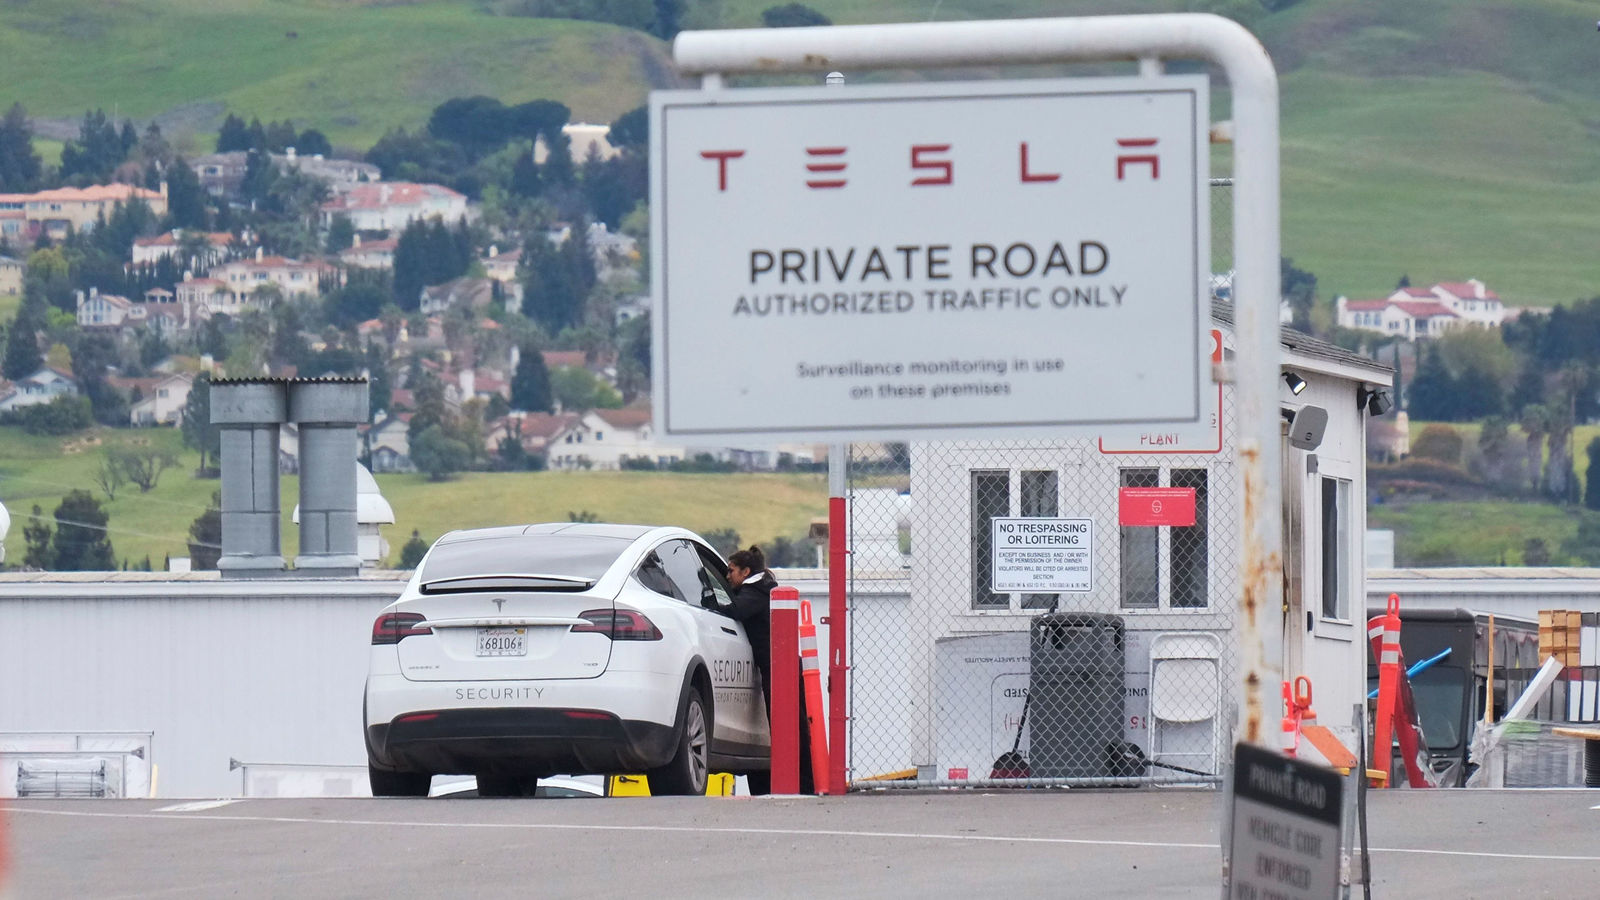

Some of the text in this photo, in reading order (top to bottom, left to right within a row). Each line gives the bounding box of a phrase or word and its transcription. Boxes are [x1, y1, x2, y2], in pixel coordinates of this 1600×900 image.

[700, 137, 1160, 192] TESLA
[750, 241, 1110, 284] PRIVATE ROAD
[733, 284, 1128, 318] AUTHORIZED TRAFFIC ONLY
[797, 357, 1065, 378] Surveillance monitoring in use
[851, 381, 1012, 399] on these premises
[1140, 433, 1180, 445] PLANT
[1000, 524, 1087, 533] NO TRESPASSING
[1008, 535, 1079, 544] OR LOITERING
[485, 637, 516, 650] 68106
[455, 687, 545, 700] SECURITY
